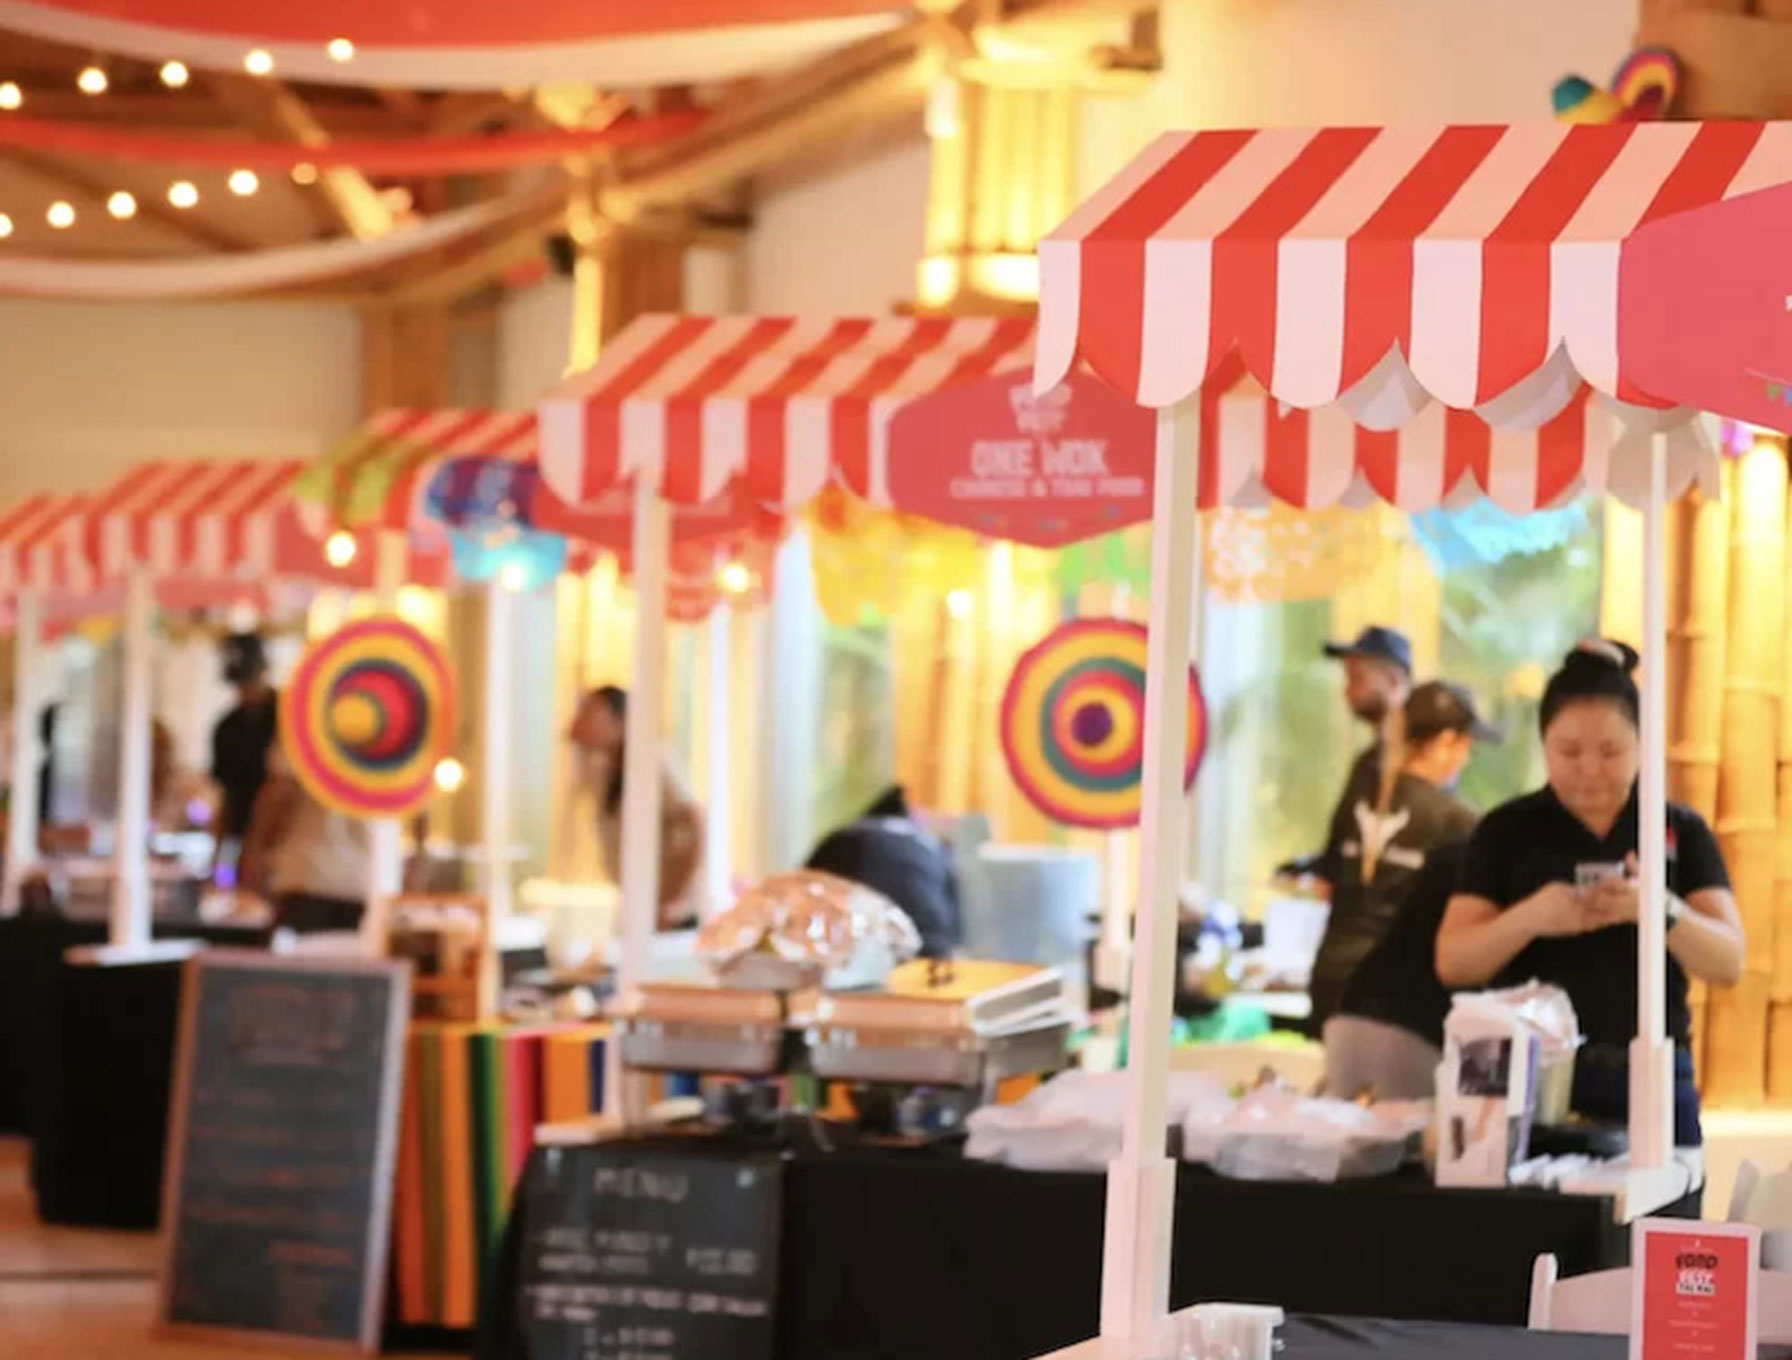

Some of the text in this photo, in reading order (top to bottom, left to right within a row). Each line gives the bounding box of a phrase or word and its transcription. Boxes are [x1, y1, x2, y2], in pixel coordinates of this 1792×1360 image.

[971, 437, 1110, 477] ONE WOK
[594, 1167, 688, 1203] MENU
